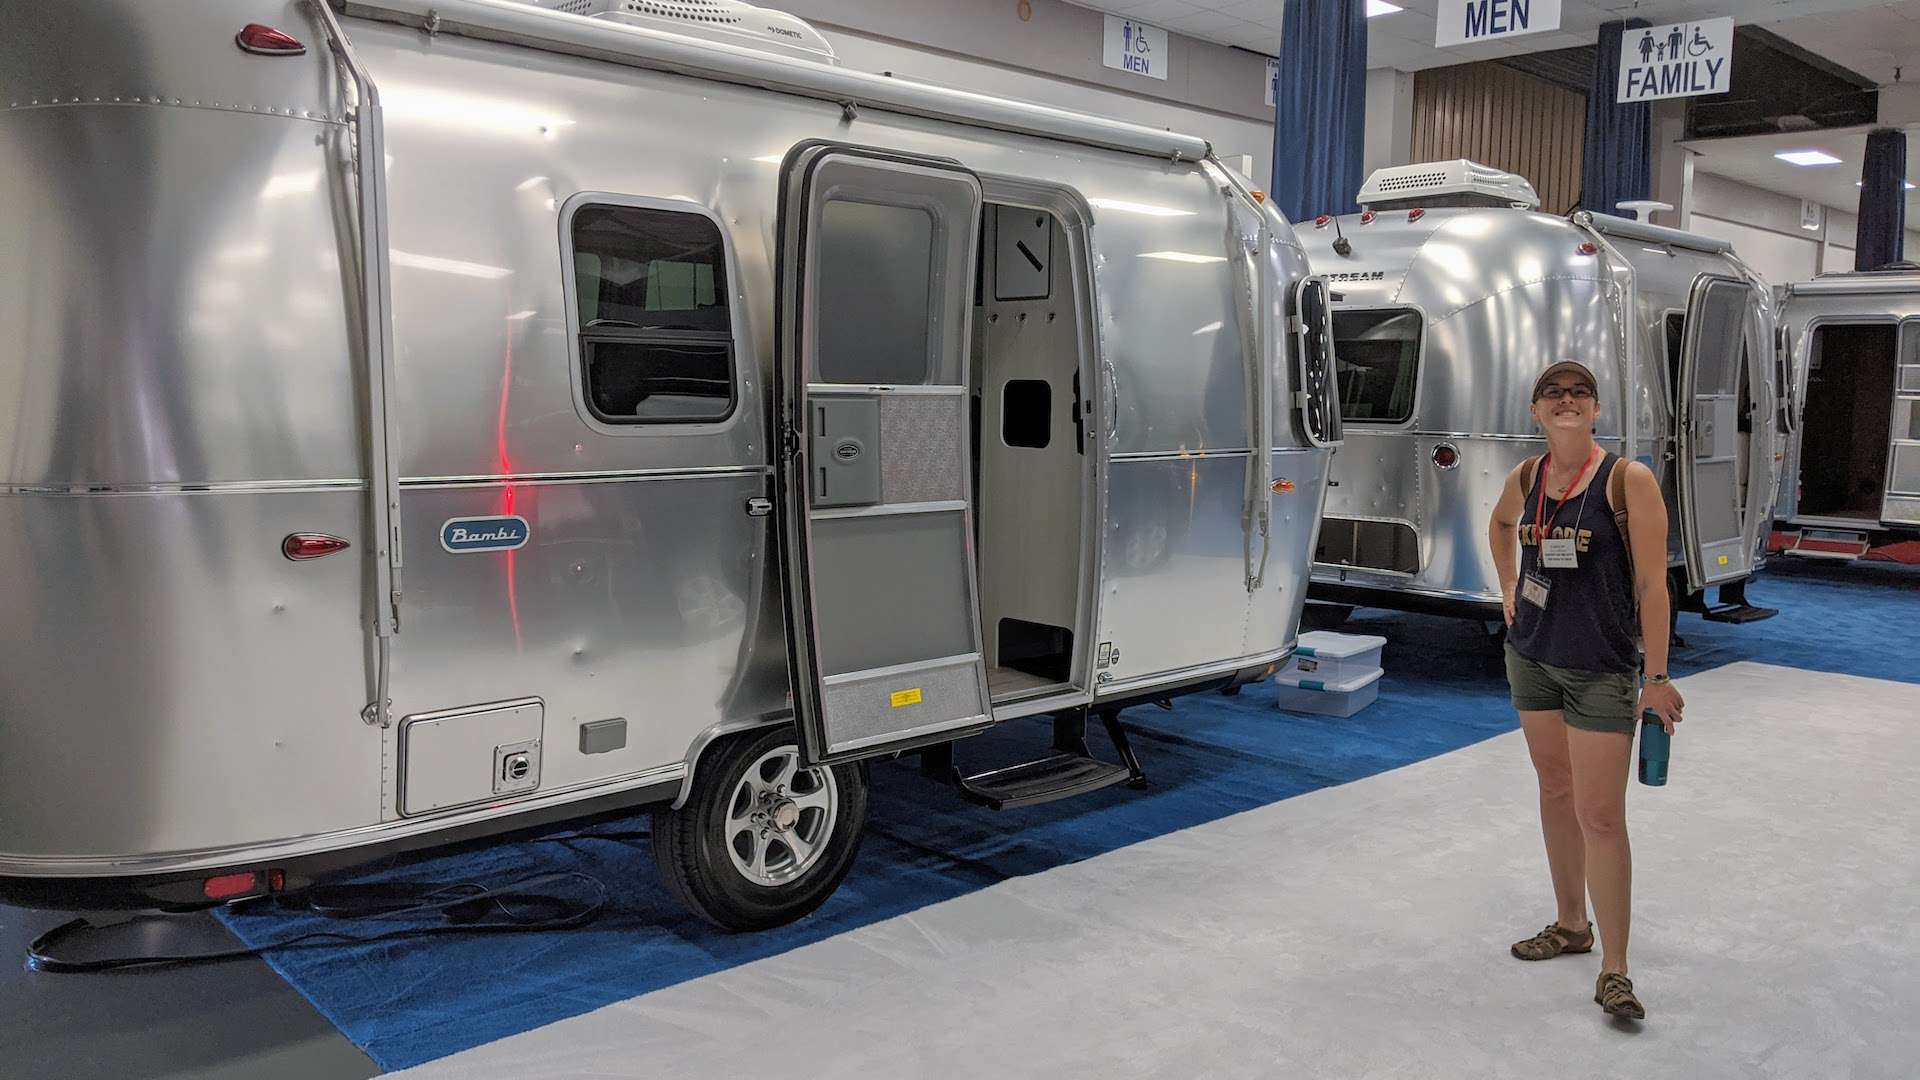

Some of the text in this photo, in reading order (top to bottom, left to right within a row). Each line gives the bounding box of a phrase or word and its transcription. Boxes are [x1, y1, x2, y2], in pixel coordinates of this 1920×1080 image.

[1464, 0, 1530, 38] MEN
[1123, 54, 1149, 74] MEN
[1626, 57, 1724, 98] FAMILY
[450, 527, 521, 543] Bambi
